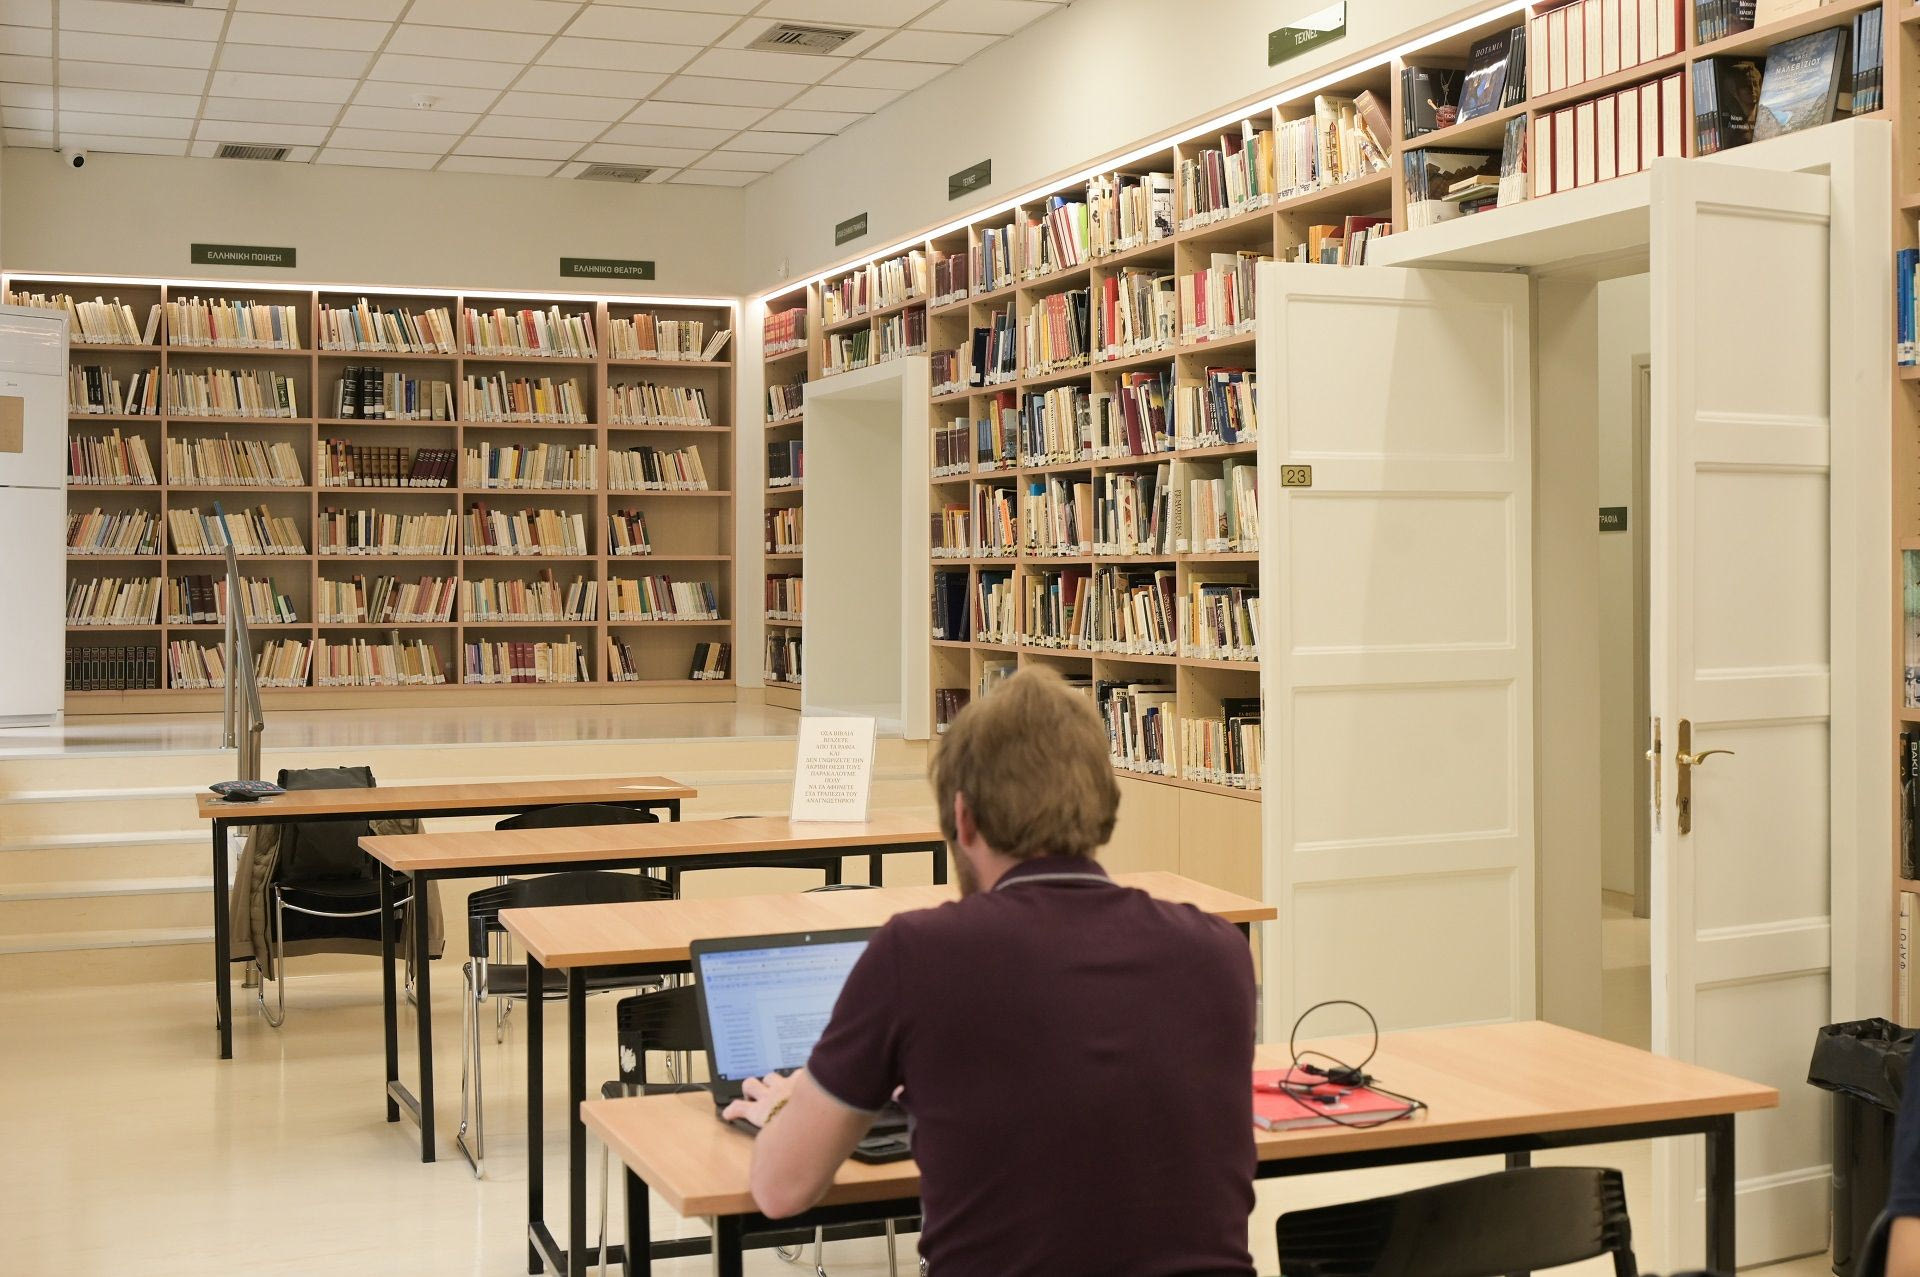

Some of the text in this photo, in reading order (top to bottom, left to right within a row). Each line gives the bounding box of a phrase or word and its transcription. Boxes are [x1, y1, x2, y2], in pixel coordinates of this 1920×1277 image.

[207, 251, 282, 262] ΕΛΛΗΝΙΚΗ ΠΟΙΗΣΗ
[573, 264, 643, 275] ΕΛΛΗΝΙΚΟ ΘΕΑΤΡΟ
[1287, 469, 1306, 484] 23
[1911, 741, 1919, 777] BAKU
